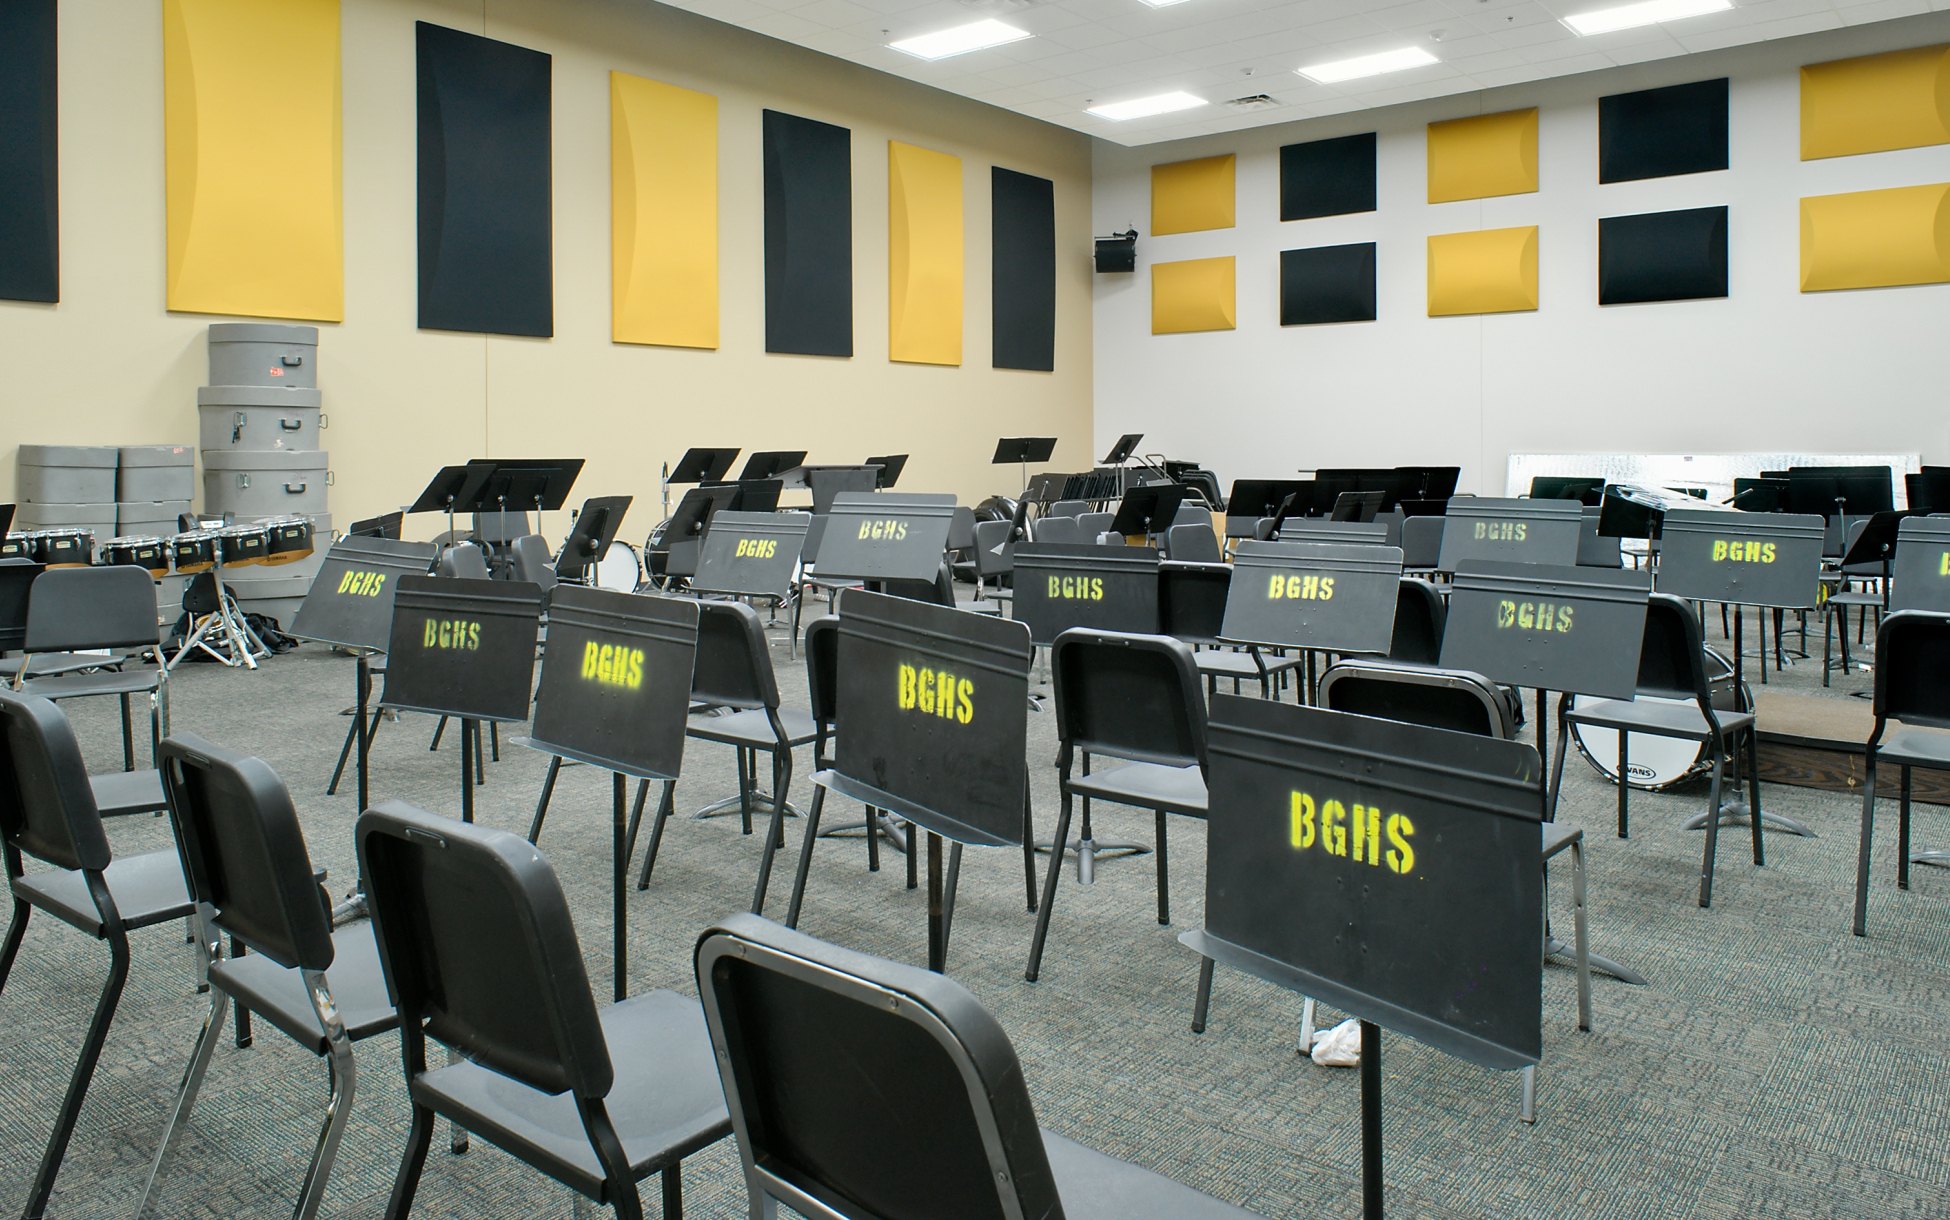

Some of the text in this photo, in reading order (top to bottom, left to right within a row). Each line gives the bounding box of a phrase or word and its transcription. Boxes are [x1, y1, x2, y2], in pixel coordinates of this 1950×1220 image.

[858, 519, 908, 540] BGHS
[1474, 522, 1527, 541] BGHS
[736, 539, 777, 558] BGHS
[1712, 540, 1776, 563] BGHS
[337, 571, 386, 597] BGHS
[1048, 575, 1103, 601] BGHS
[1269, 575, 1334, 600] BGHS
[1498, 600, 1574, 632] BGHS
[423, 618, 481, 650] BGHS
[581, 640, 644, 689] BGHS
[898, 663, 974, 724] BGHS
[1625, 767, 1651, 777] VANS
[1290, 790, 1415, 874] BGHS
